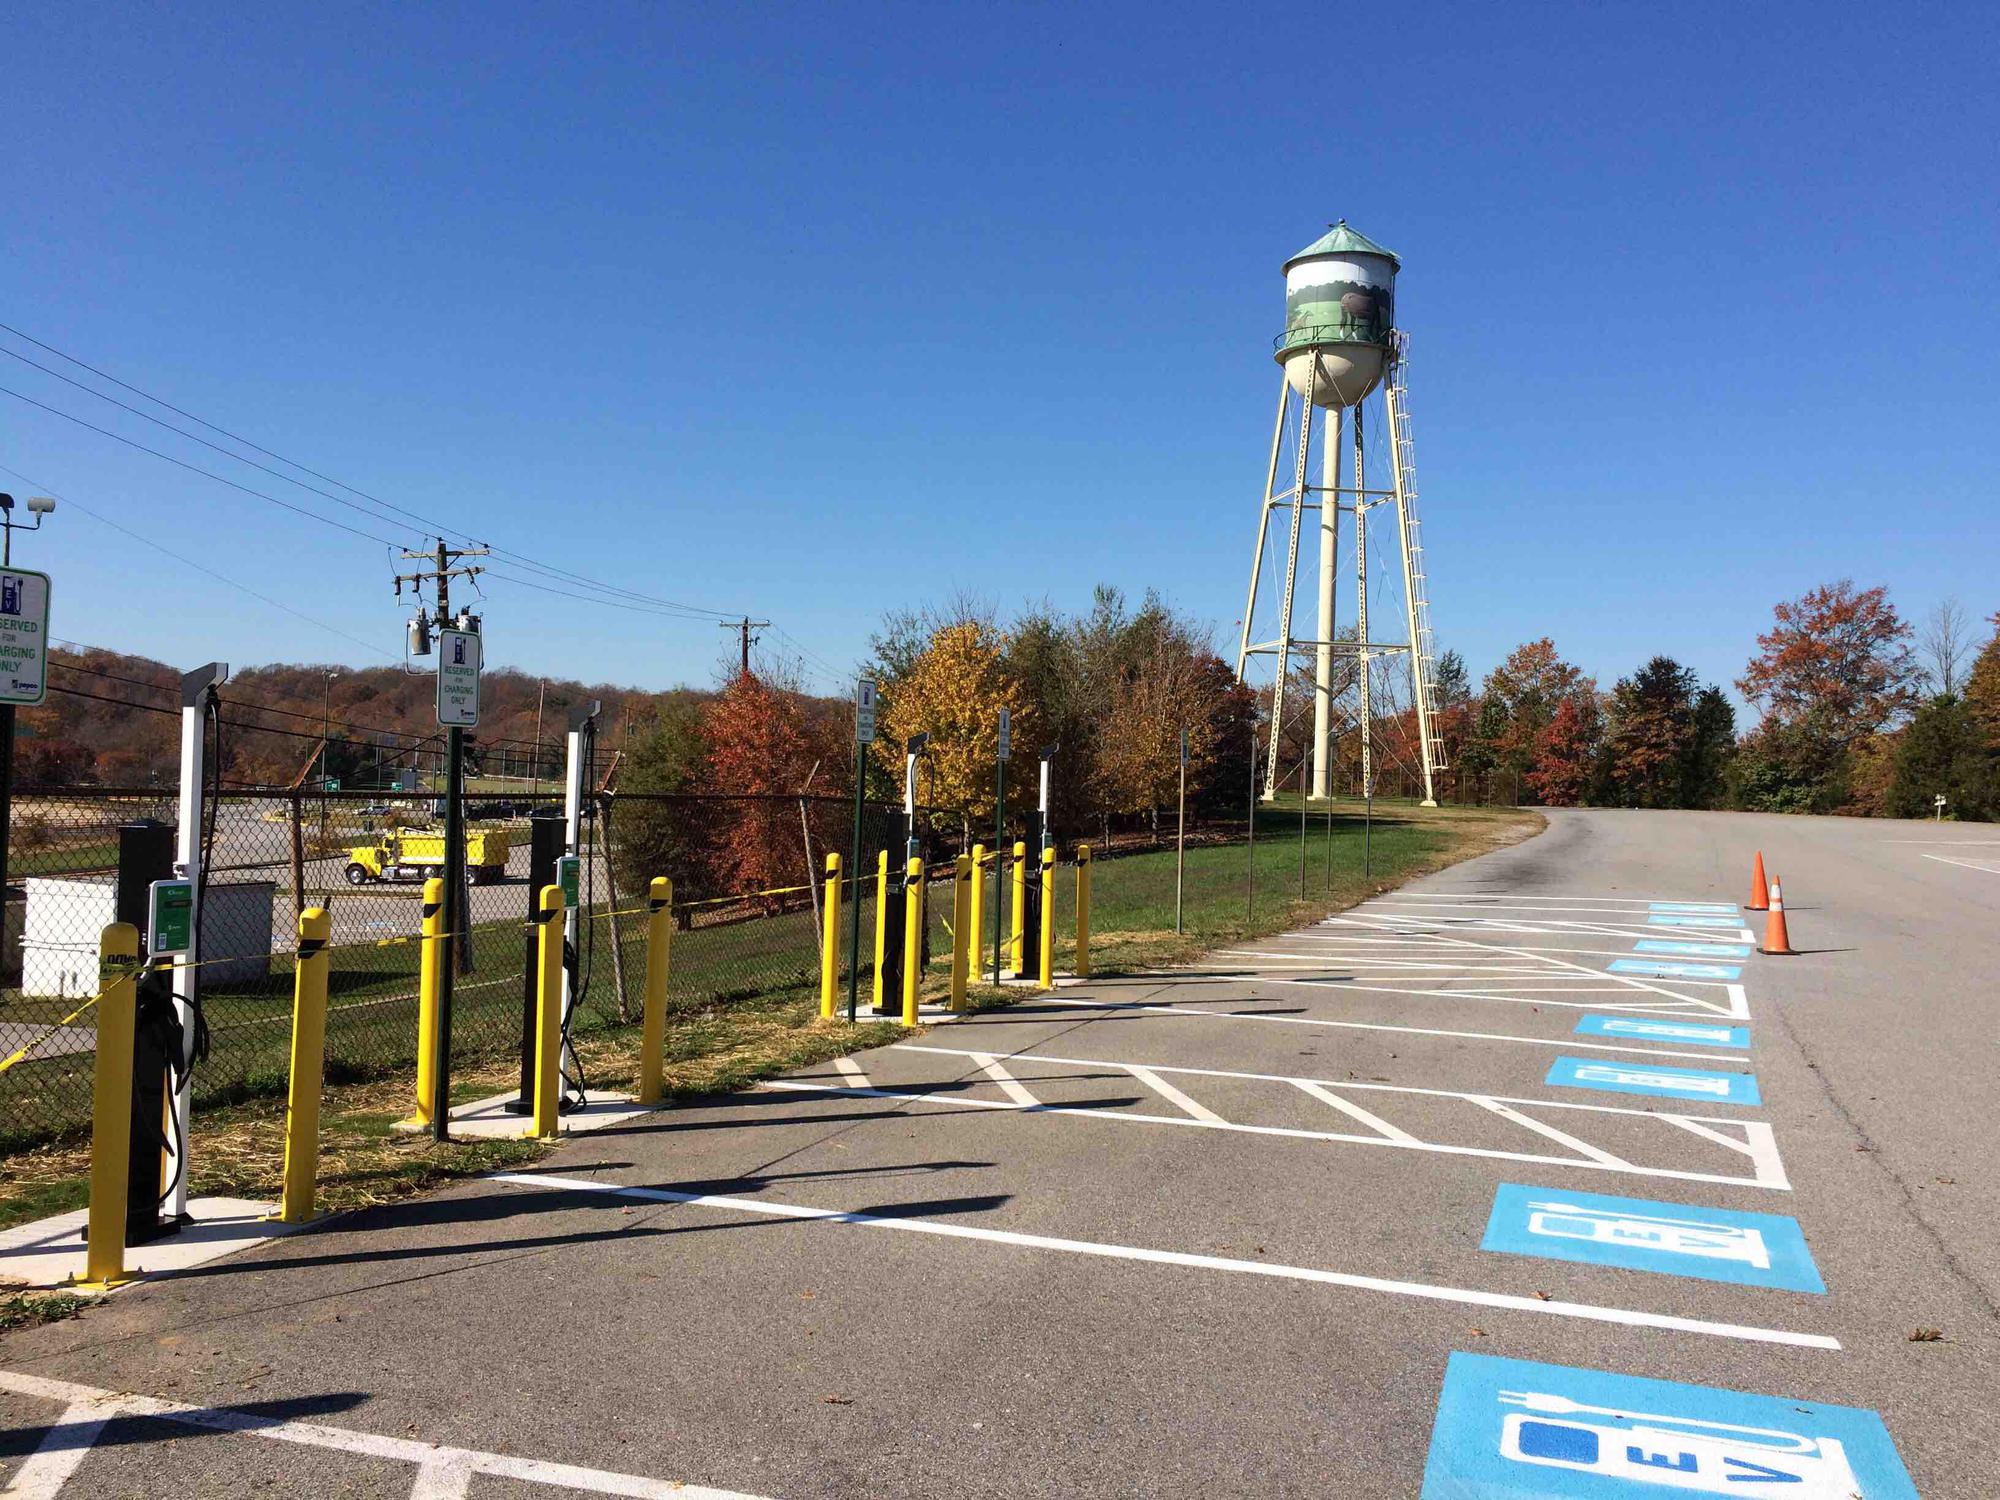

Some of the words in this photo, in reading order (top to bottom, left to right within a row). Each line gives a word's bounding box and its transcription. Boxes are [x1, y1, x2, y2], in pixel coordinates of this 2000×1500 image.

[2, 633, 16, 642] FOR
[0, 660, 21, 673] NLY
[445, 666, 474, 676] RESERVED
[451, 696, 466, 704] ONLY
[1626, 1445, 1804, 1483] EV
